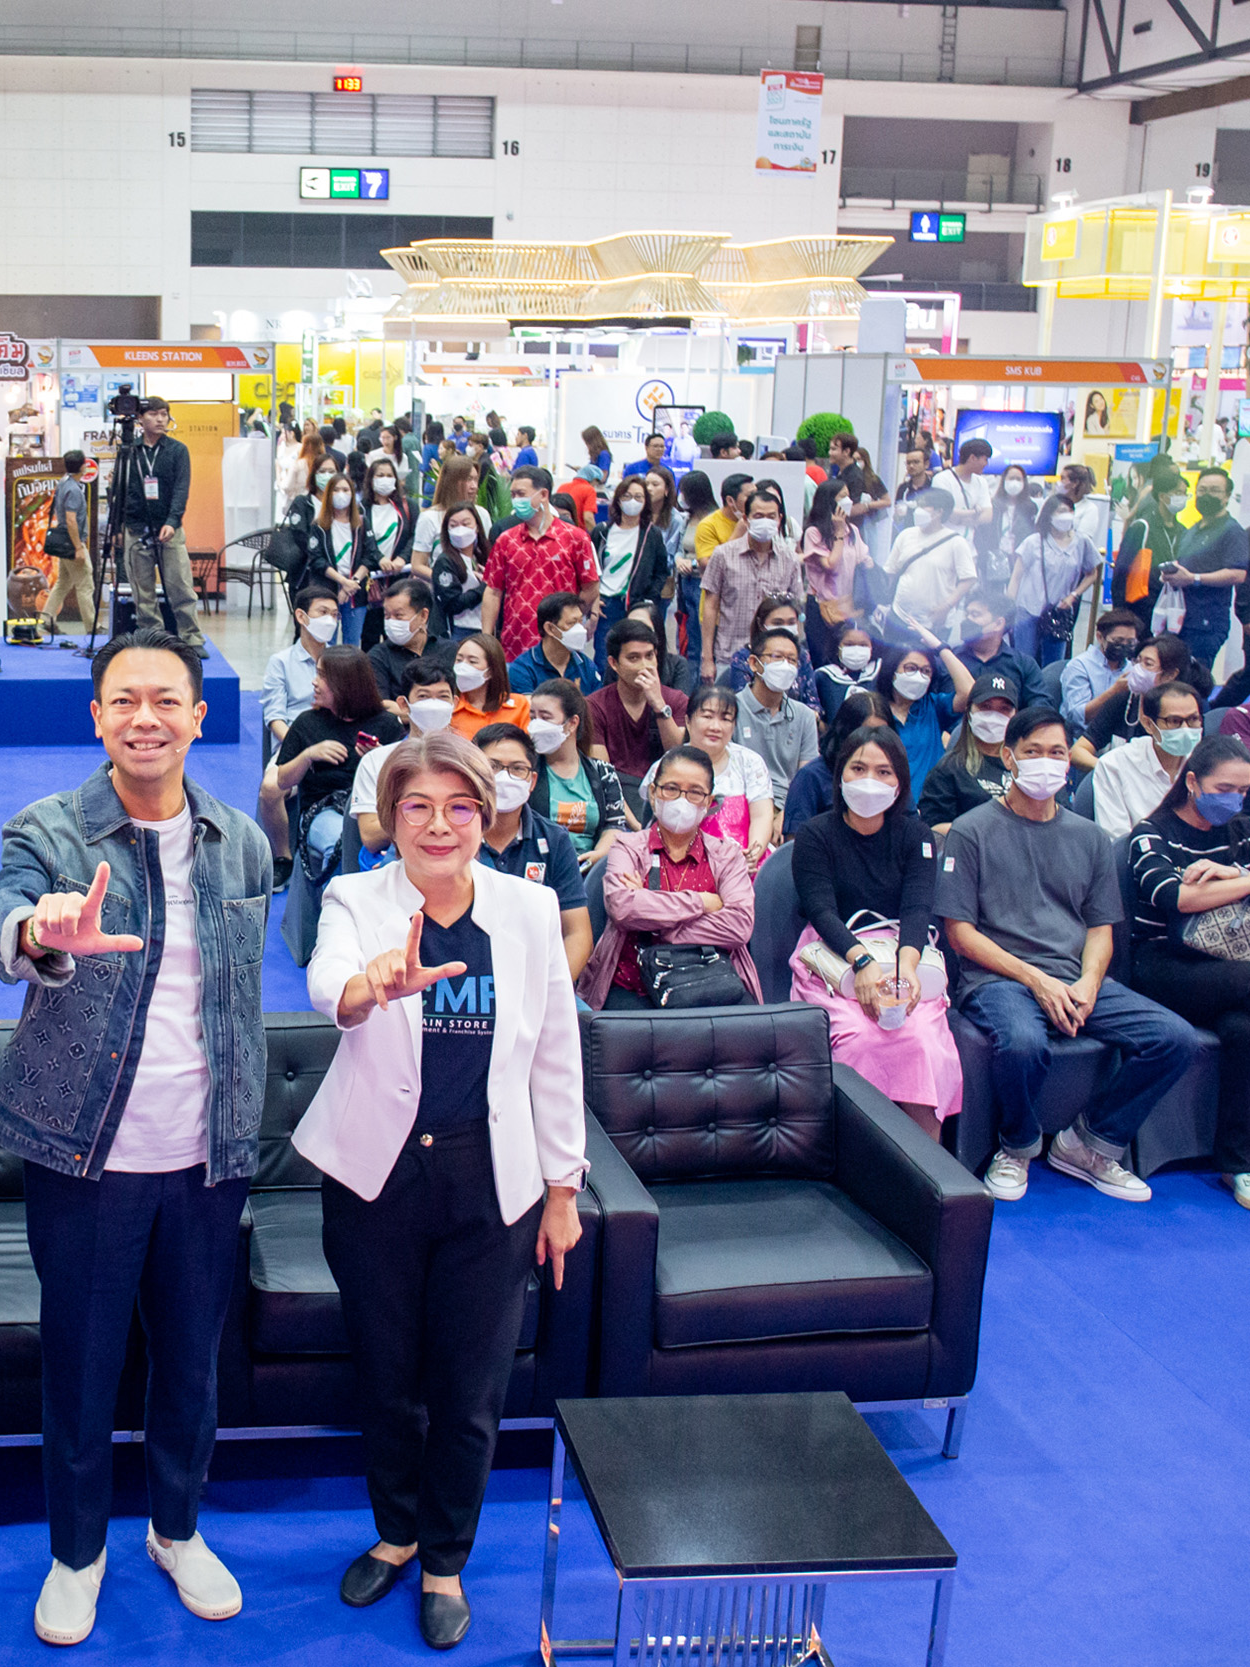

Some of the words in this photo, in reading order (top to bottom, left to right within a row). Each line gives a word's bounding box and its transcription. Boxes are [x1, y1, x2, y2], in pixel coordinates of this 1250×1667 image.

[168, 131, 186, 148] 15
[502, 140, 520, 156] 16
[822, 149, 837, 164] 17
[1056, 157, 1072, 173] 18
[1195, 163, 1211, 177] 19
[362, 170, 384, 198] 7
[941, 227, 962, 236] EXIT
[124, 351, 159, 362] KLEENS
[161, 351, 203, 362] STATION
[1004, 365, 1023, 376] SMS
[421, 1018, 443, 1028] AIN
[448, 1019, 488, 1029] STORE
[477, 1029, 495, 1037] Syste
